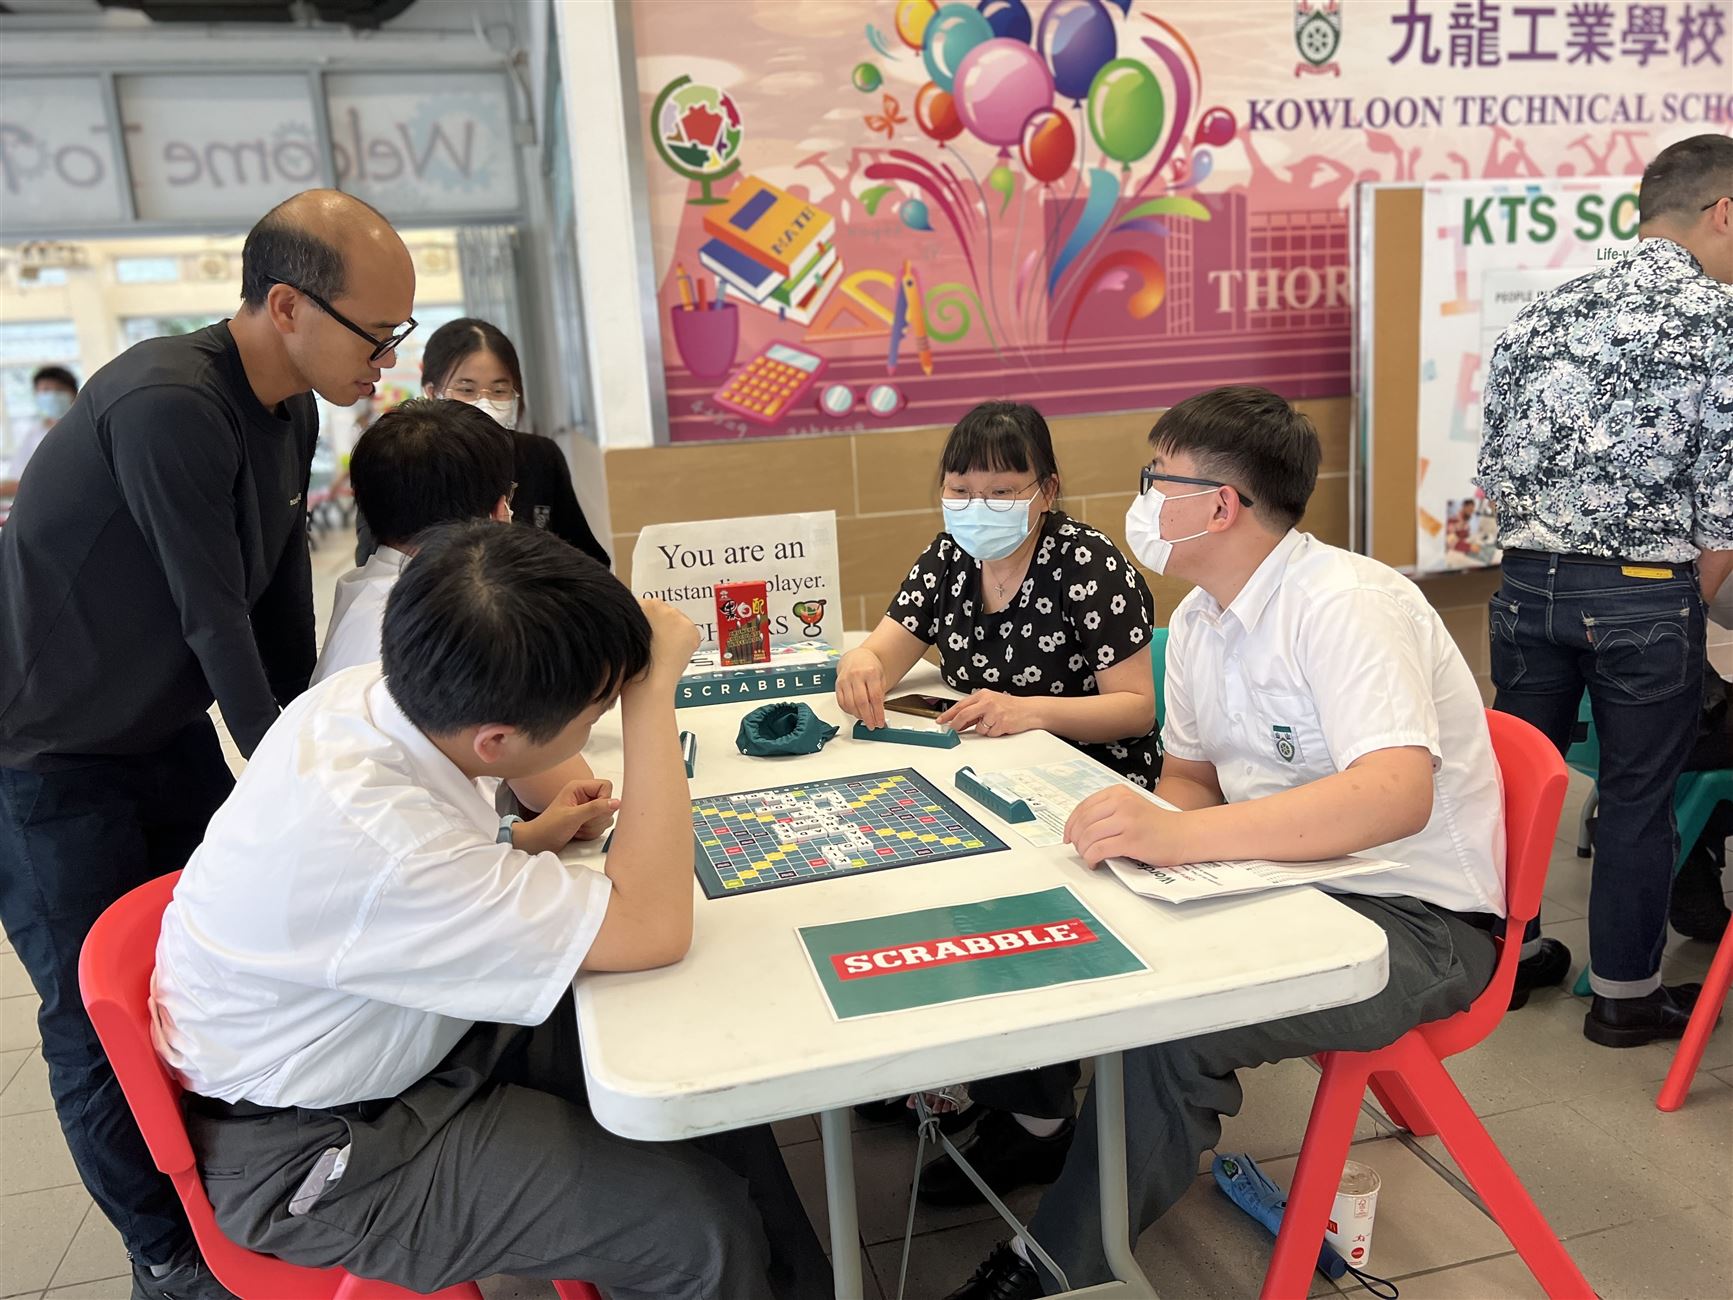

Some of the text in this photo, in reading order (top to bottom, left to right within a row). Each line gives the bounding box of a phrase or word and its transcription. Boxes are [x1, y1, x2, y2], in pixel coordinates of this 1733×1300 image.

[1387, 0, 1726, 68] 九龍工業學校
[1248, 97, 1444, 131] KOWLOON
[1454, 94, 1654, 126] TECHNICAL
[1462, 194, 1558, 245] KTS
[1208, 265, 1351, 314] THOR
[658, 541, 806, 570] You are an
[683, 674, 822, 699] SCRABBLE
